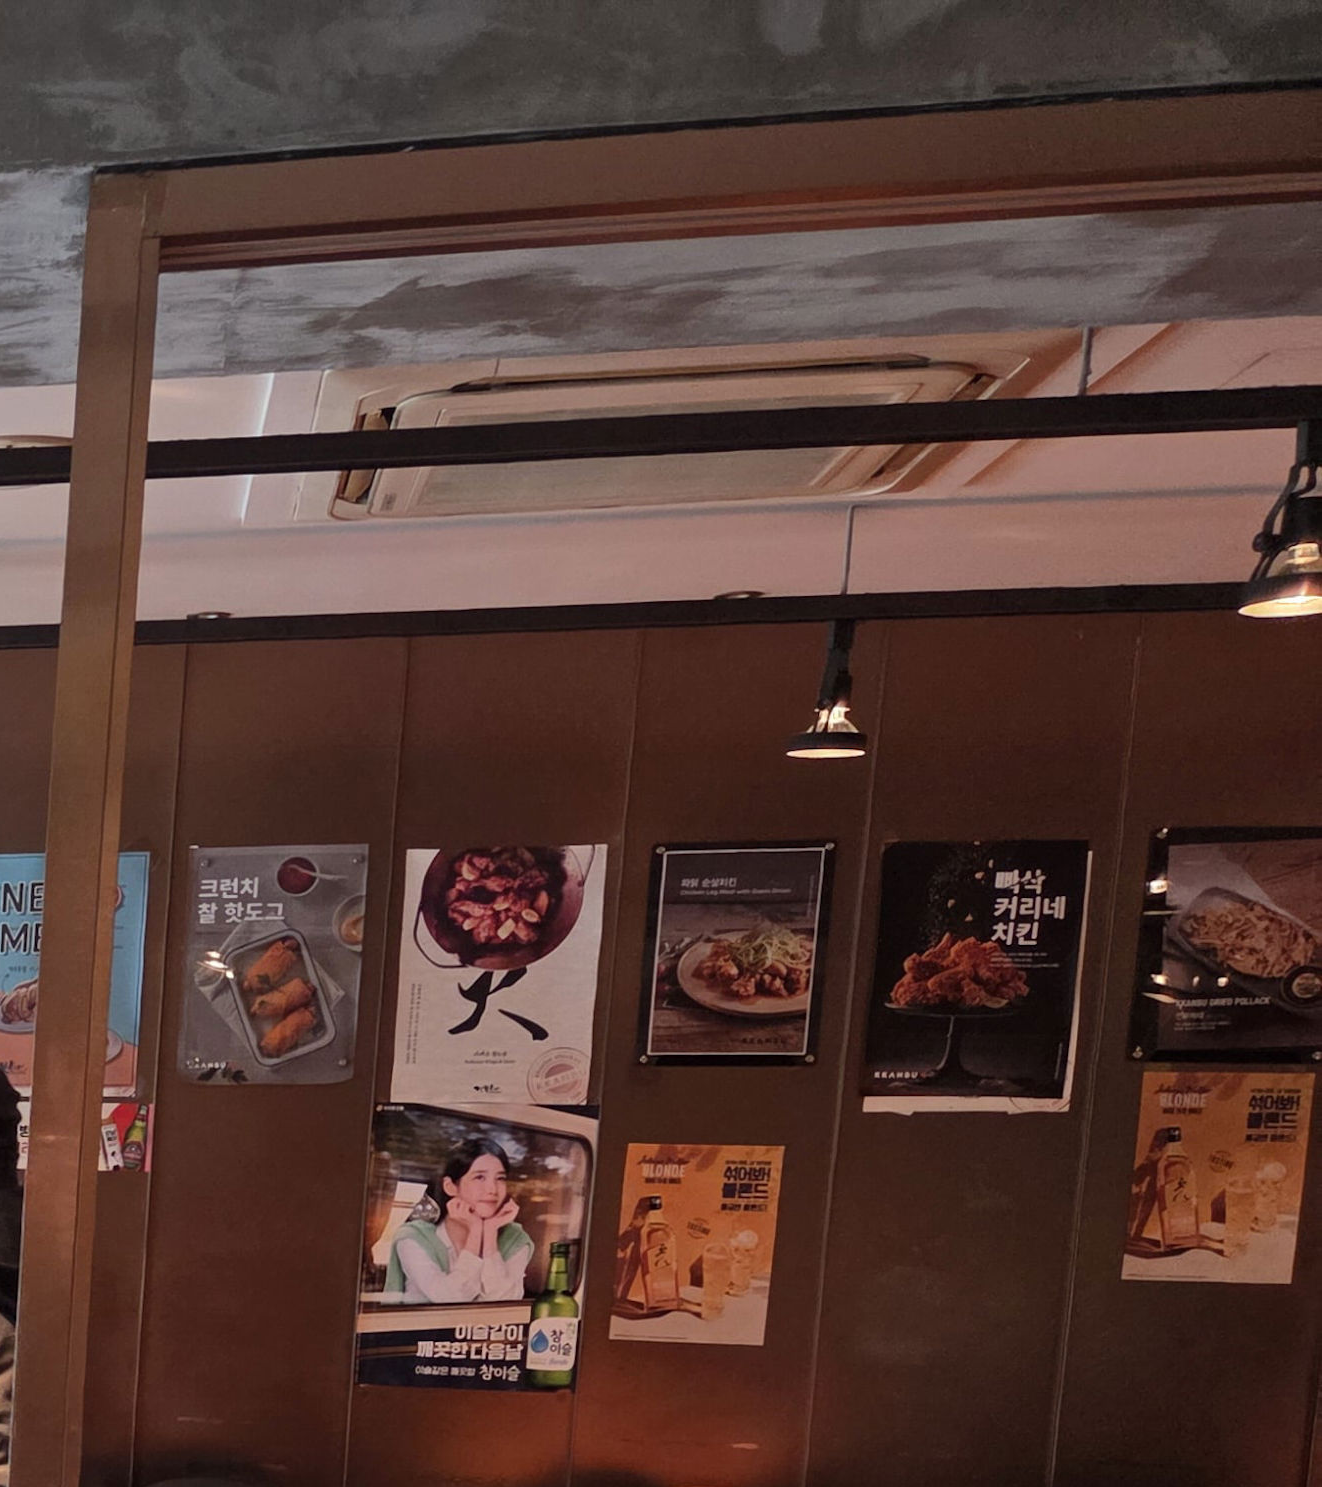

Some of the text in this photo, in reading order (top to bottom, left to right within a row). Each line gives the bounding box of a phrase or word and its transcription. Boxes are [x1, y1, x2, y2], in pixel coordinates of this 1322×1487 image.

[1, 881, 44, 914] NE
[198, 876, 259, 898] 크런치
[198, 902, 285, 924] 찰 핫도그
[993, 895, 1066, 920] 커리네
[991, 921, 1039, 946] 치킨
[641, 1163, 685, 1178] BLONDE
[416, 1341, 524, 1360] 깨끗한 다음날
